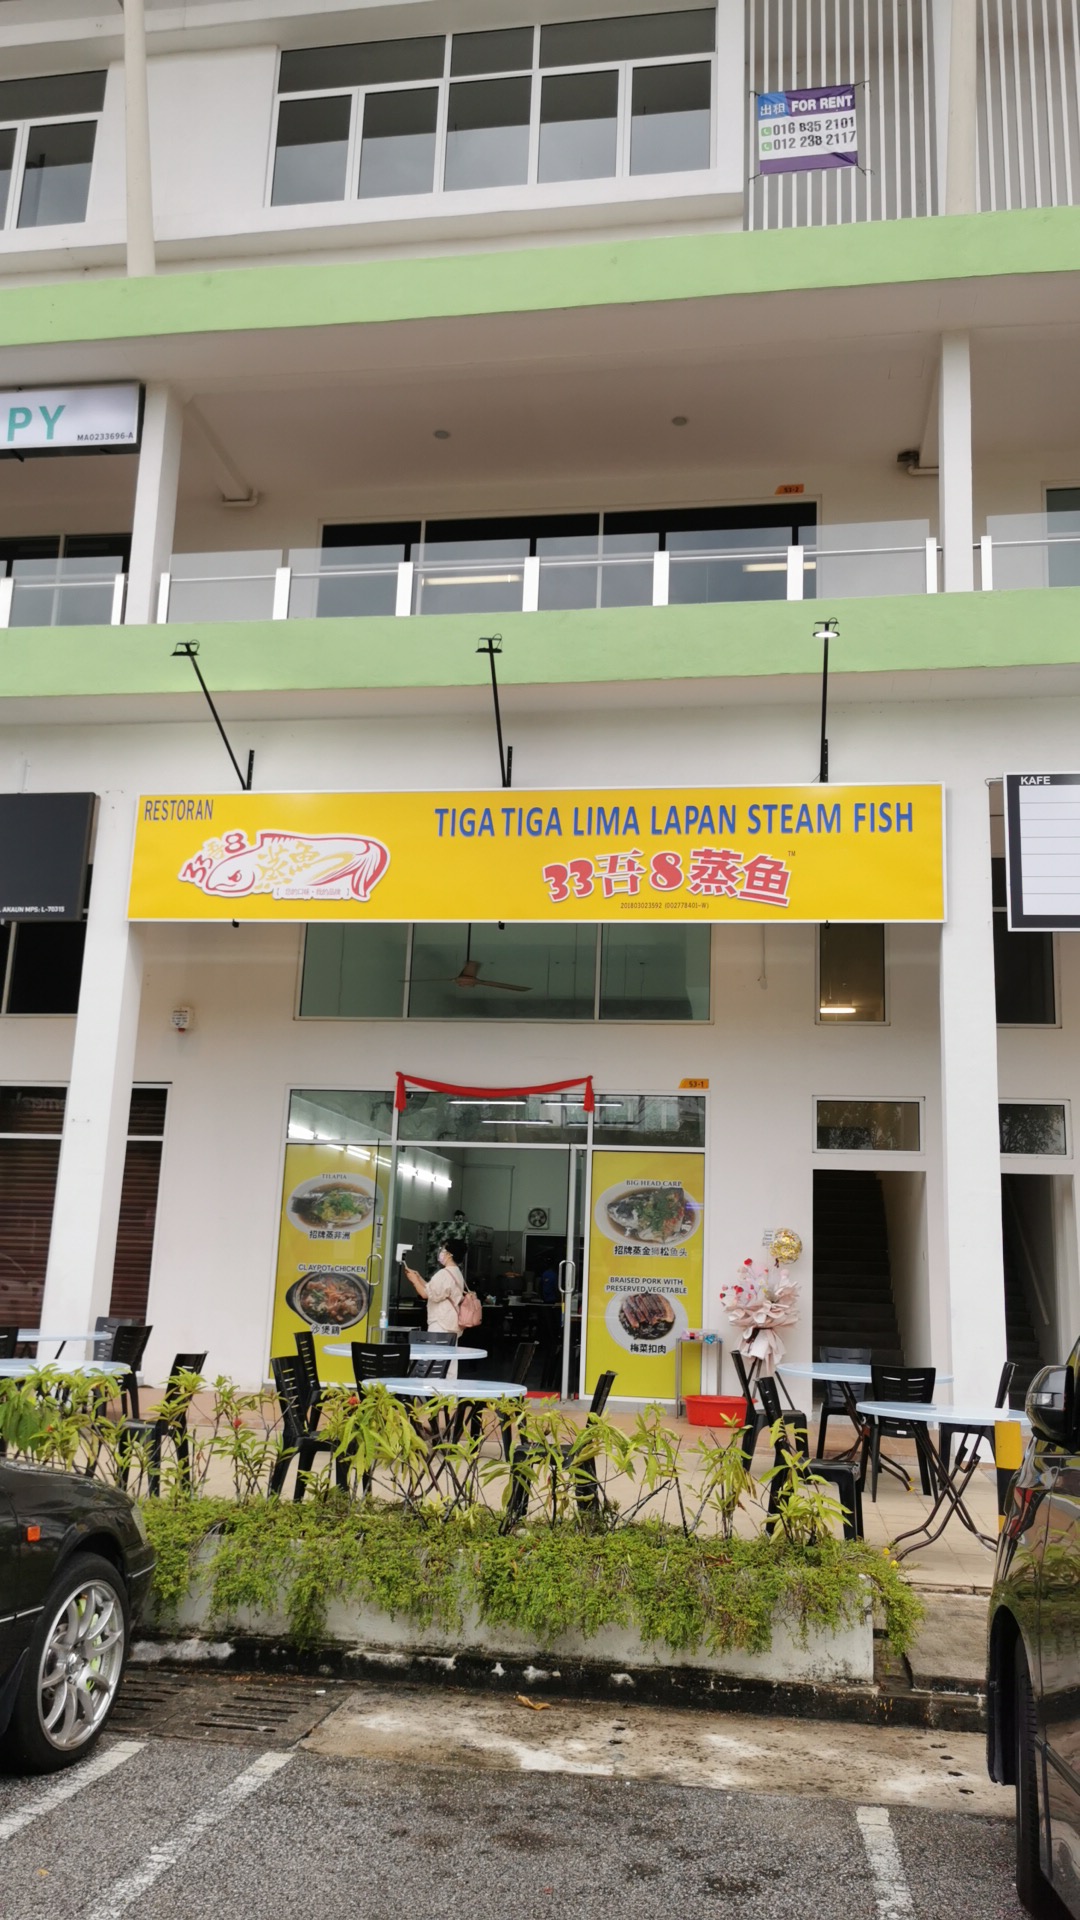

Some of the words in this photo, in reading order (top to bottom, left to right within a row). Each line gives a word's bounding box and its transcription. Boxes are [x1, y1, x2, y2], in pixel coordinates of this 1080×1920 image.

[760, 103, 785, 116] 出租
[791, 99, 817, 113] FOR
[820, 95, 853, 110] RENT
[773, 122, 796, 136] 016
[825, 116, 855, 131] 2101
[773, 137, 796, 151] 012
[825, 130, 856, 146] 2117
[77, 431, 134, 442] MA0233696-A
[1020, 776, 1051, 786] KAFE
[144, 799, 214, 821] RESTORAN
[435, 808, 495, 837] TIGA
[501, 807, 562, 837] TIGA
[573, 806, 640, 836] LIMA
[651, 804, 737, 835] LAPAN
[747, 803, 841, 834] STEAM
[854, 802, 913, 833] FISH
[298, 1263, 332, 1271] CLAYPOT
[610, 1276, 640, 1284] BRAISED
[606, 1284, 646, 1292] PRESERVED
[647, 1285, 687, 1294] VEGETABLE
